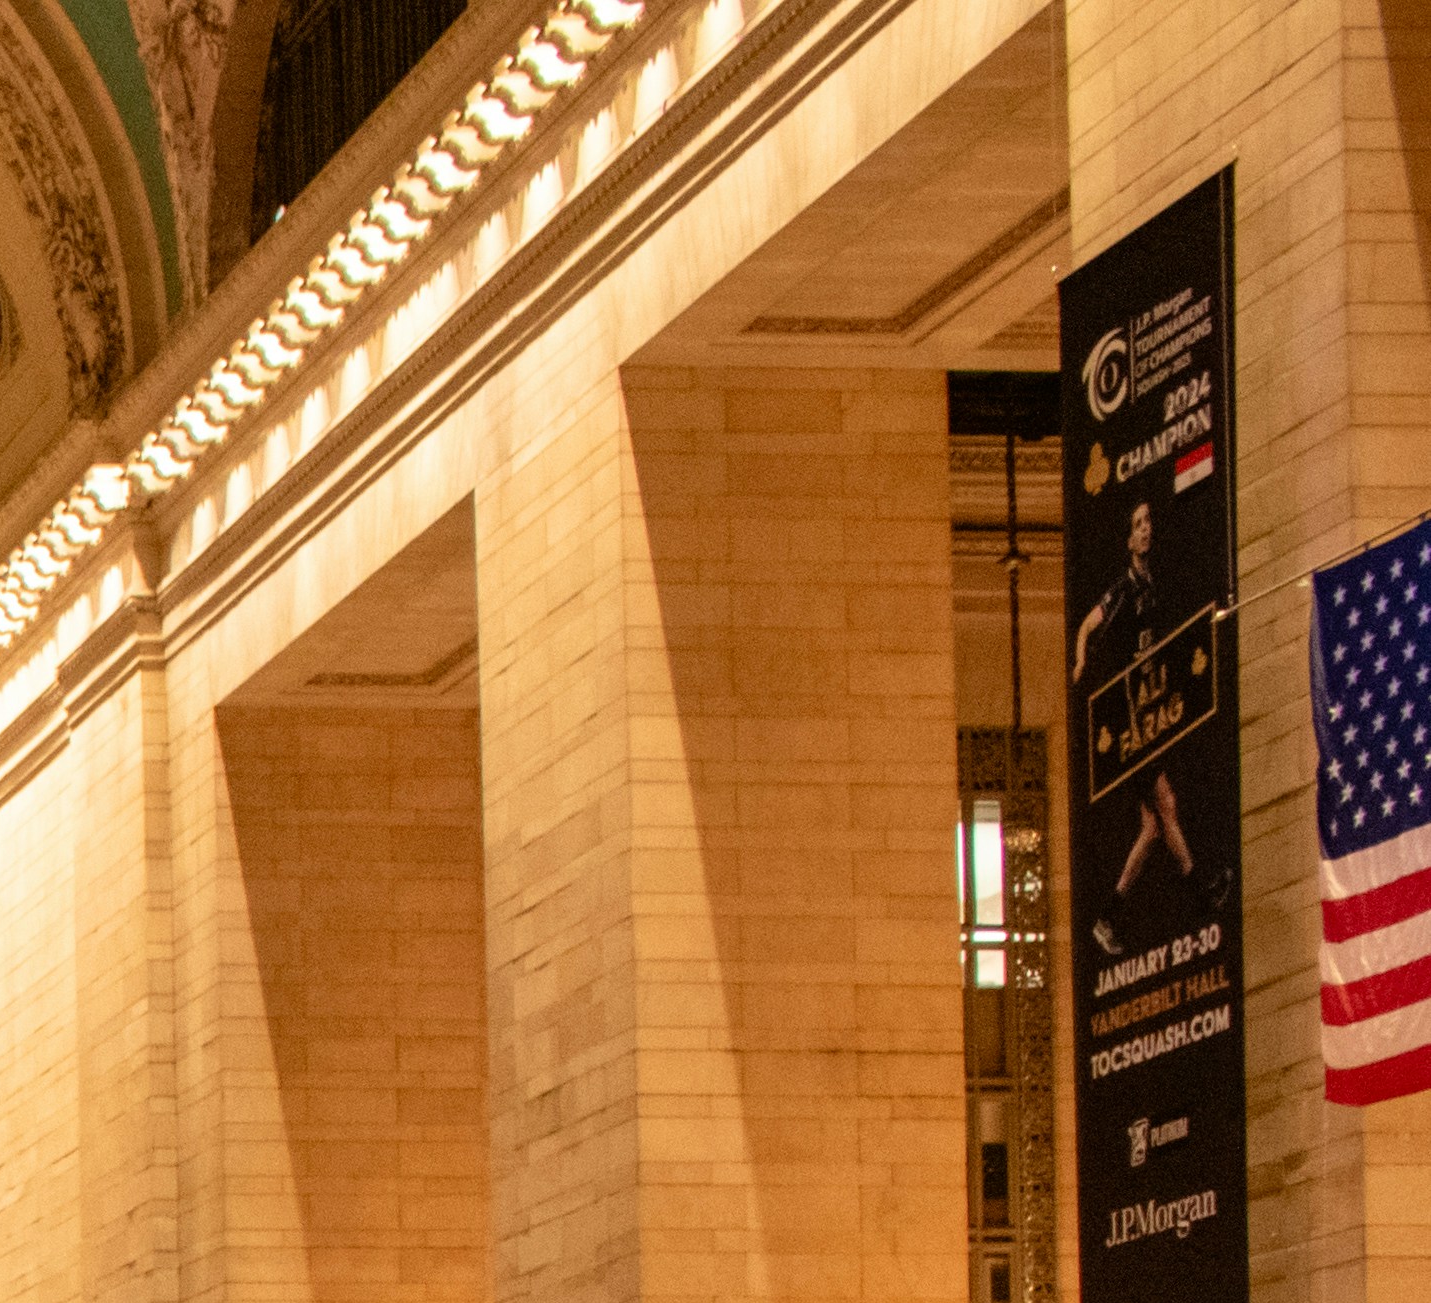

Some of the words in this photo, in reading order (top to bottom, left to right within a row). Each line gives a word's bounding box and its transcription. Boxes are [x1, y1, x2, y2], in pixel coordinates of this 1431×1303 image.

[1163, 370, 1211, 422] 2024
[1117, 402, 1211, 482] CHAMPION
[1120, 692, 1184, 762] FARAG
[1095, 946, 1167, 997] JANUARY
[1172, 923, 1221, 966] 23-30
[1090, 980, 1181, 1036] VANDERBILT
[1186, 965, 1230, 1001] HALL
[1091, 1003, 1230, 1079] TOCSQUASH.COM
[1106, 1190, 1217, 1248] J.P.Morgan
